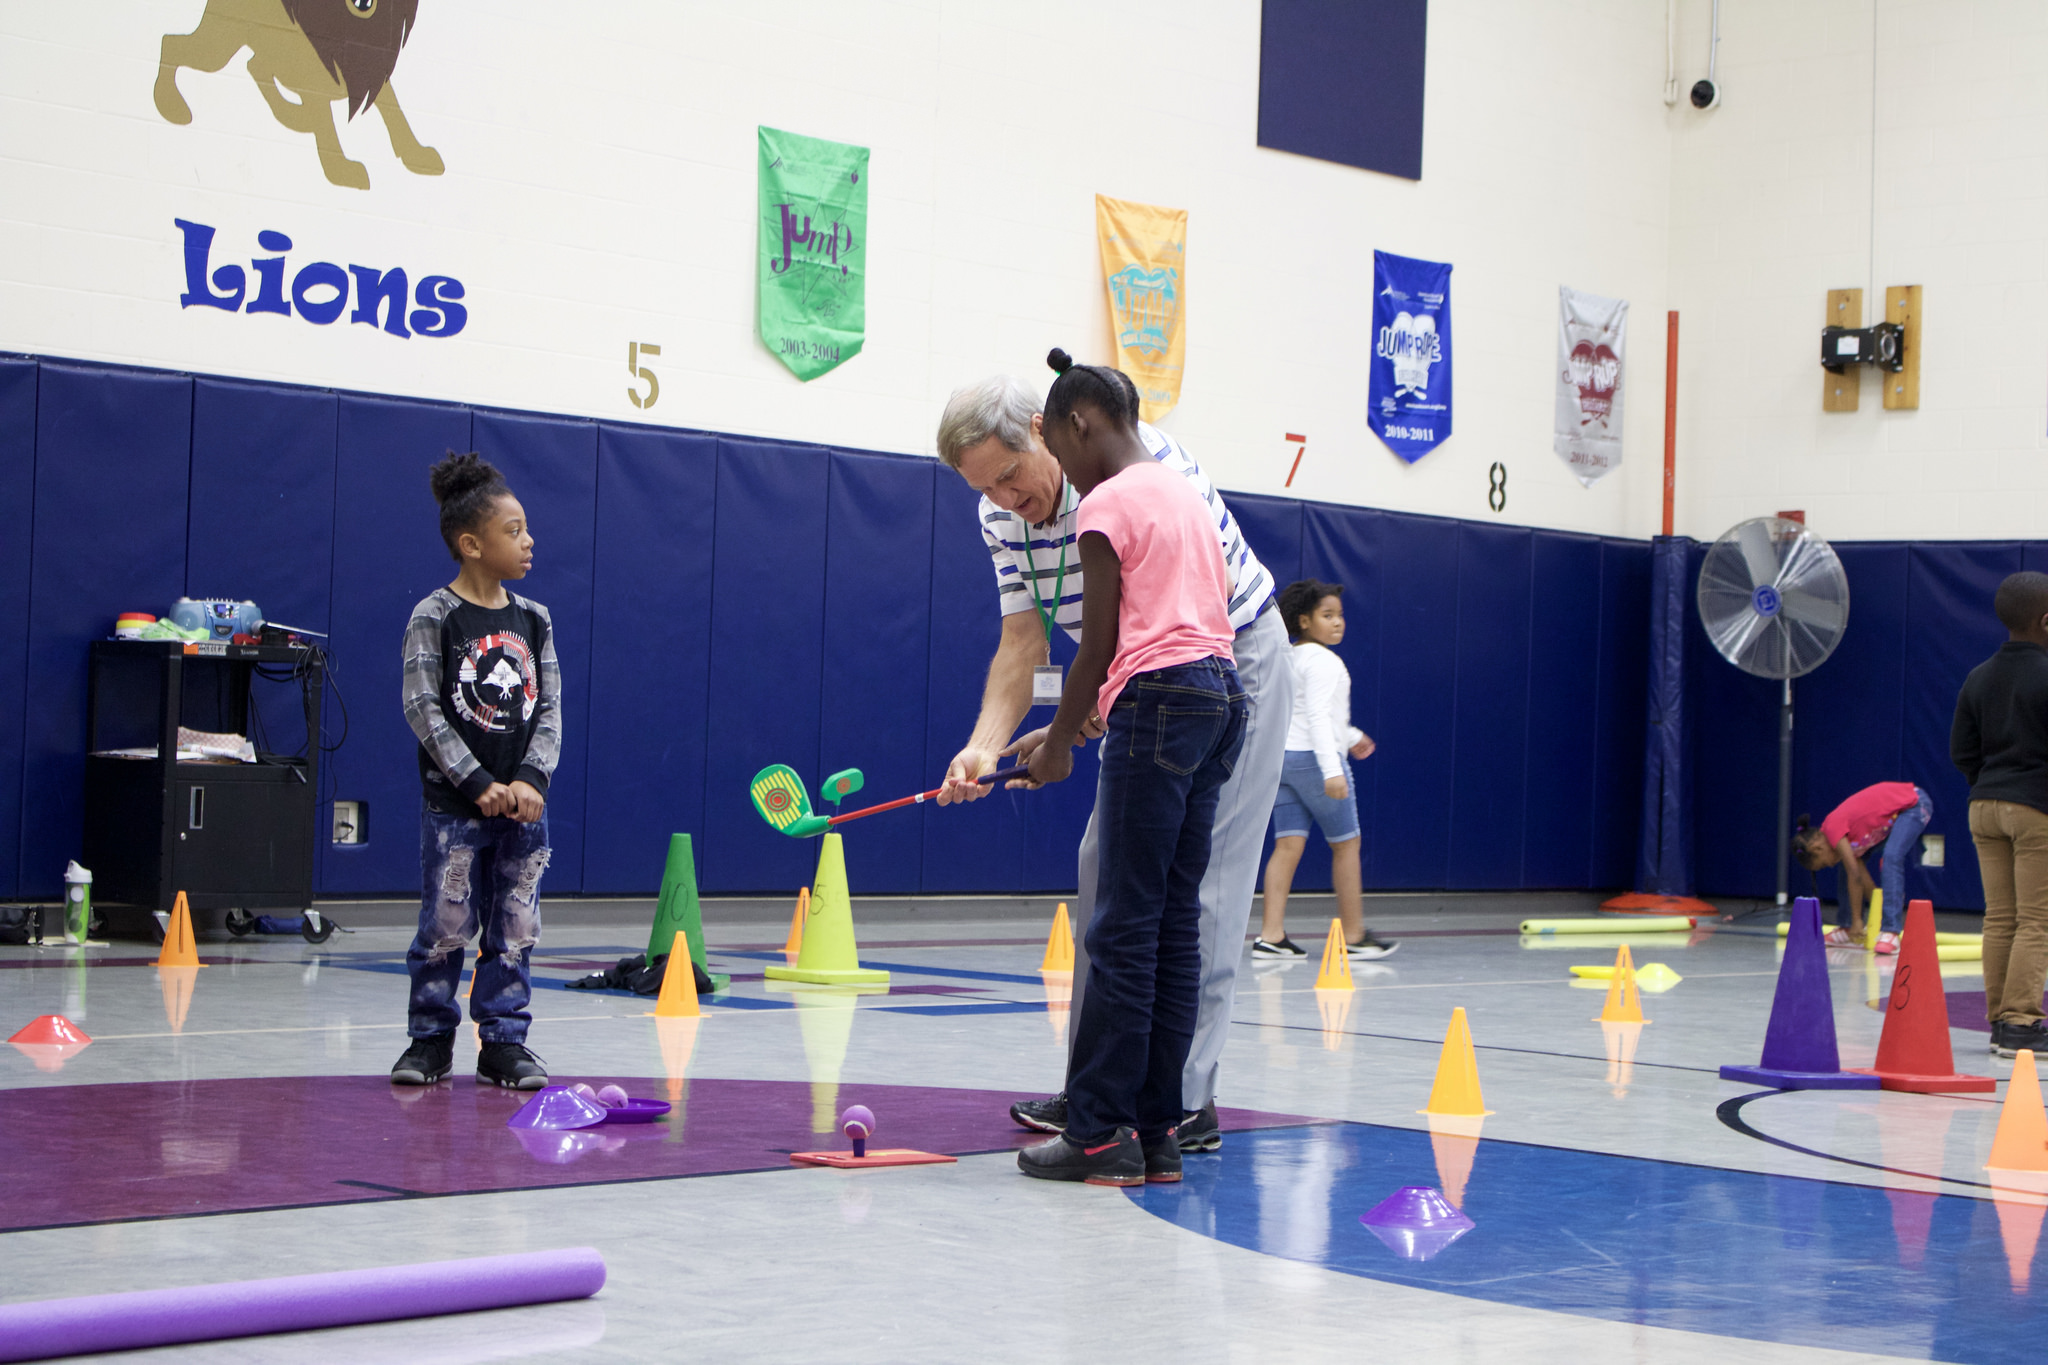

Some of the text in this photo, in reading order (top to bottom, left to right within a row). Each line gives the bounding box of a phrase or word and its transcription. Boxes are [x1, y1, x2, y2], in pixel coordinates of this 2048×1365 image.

[771, 203, 852, 273] Jump
[174, 217, 468, 340] Lions
[780, 337, 840, 363] 2003-2004
[1377, 326, 1413, 360] JUMP
[627, 341, 661, 410] 5
[1384, 424, 1435, 442] 2010-2011
[1284, 432, 1307, 488] 7
[1488, 461, 1507, 513] 8
[660, 881, 689, 922] 10
[809, 883, 827, 916] 5
[1894, 964, 1912, 1011] 3
